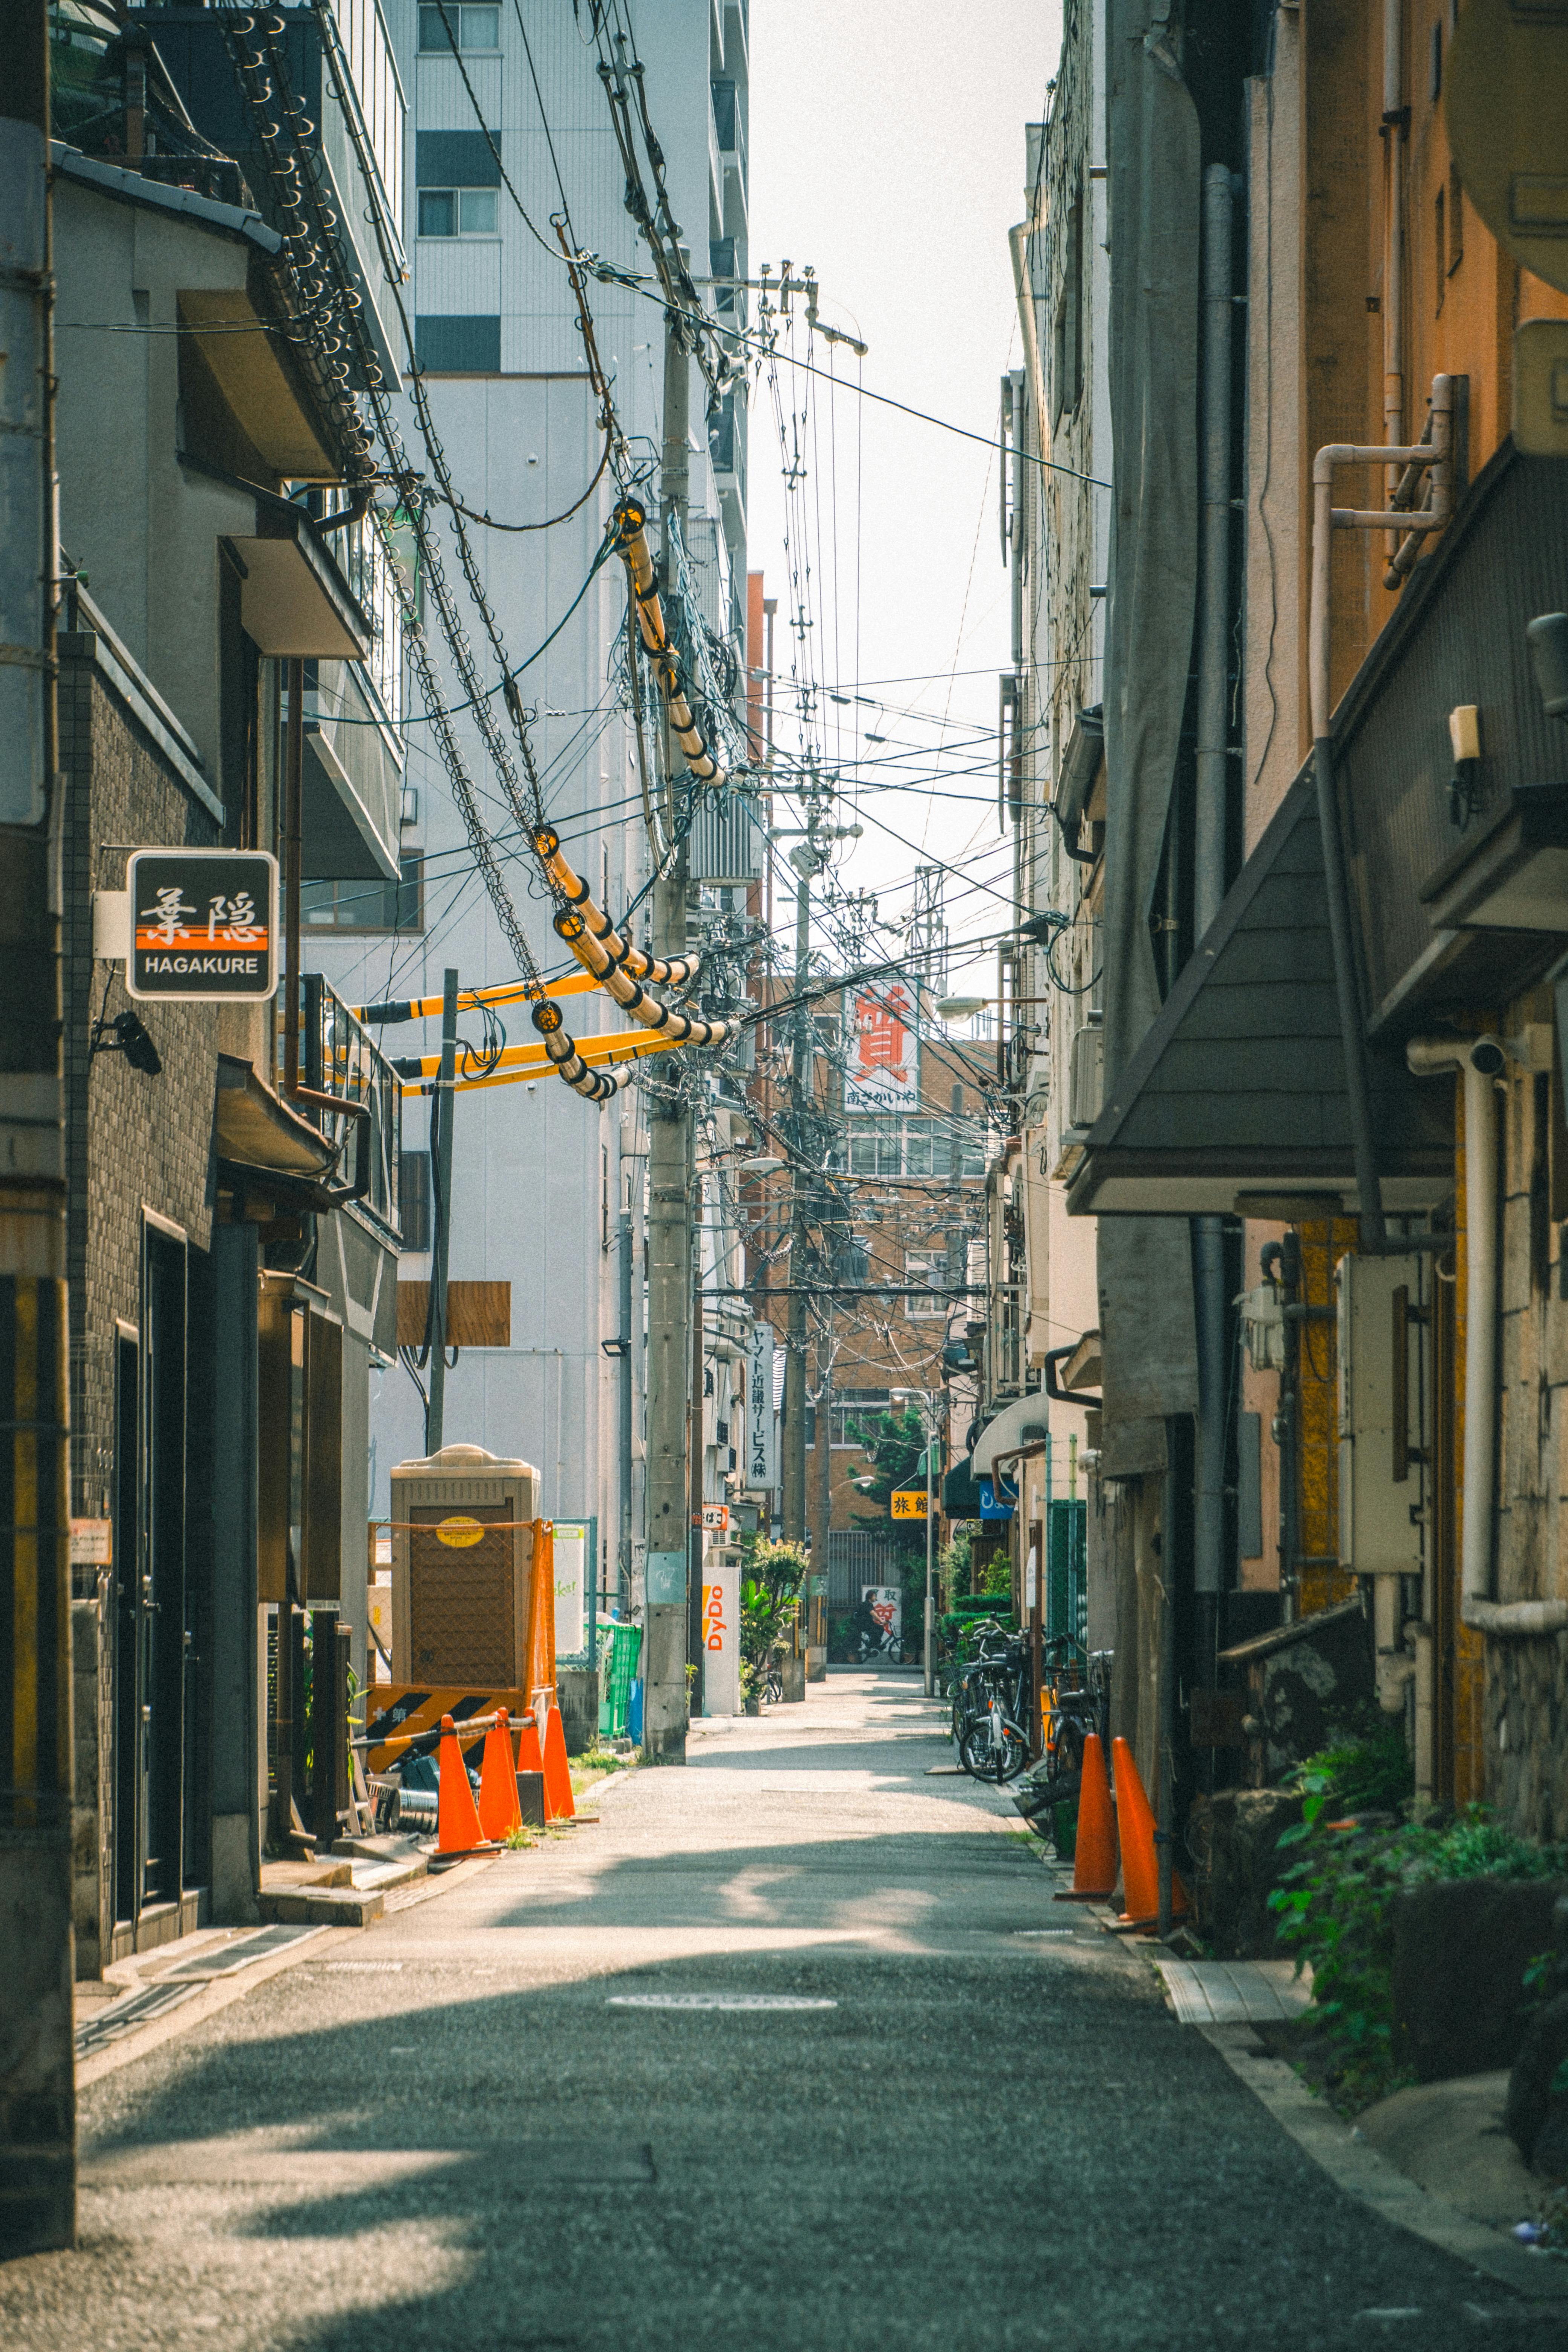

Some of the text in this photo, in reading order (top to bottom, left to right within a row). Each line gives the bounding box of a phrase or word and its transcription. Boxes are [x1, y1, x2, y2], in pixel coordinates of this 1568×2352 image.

[141, 887, 263, 945] 葉隠
[146, 957, 258, 973] HAGAKURE
[894, 1496, 928, 1514] 旅館
[708, 1585, 727, 1651] DyDo
